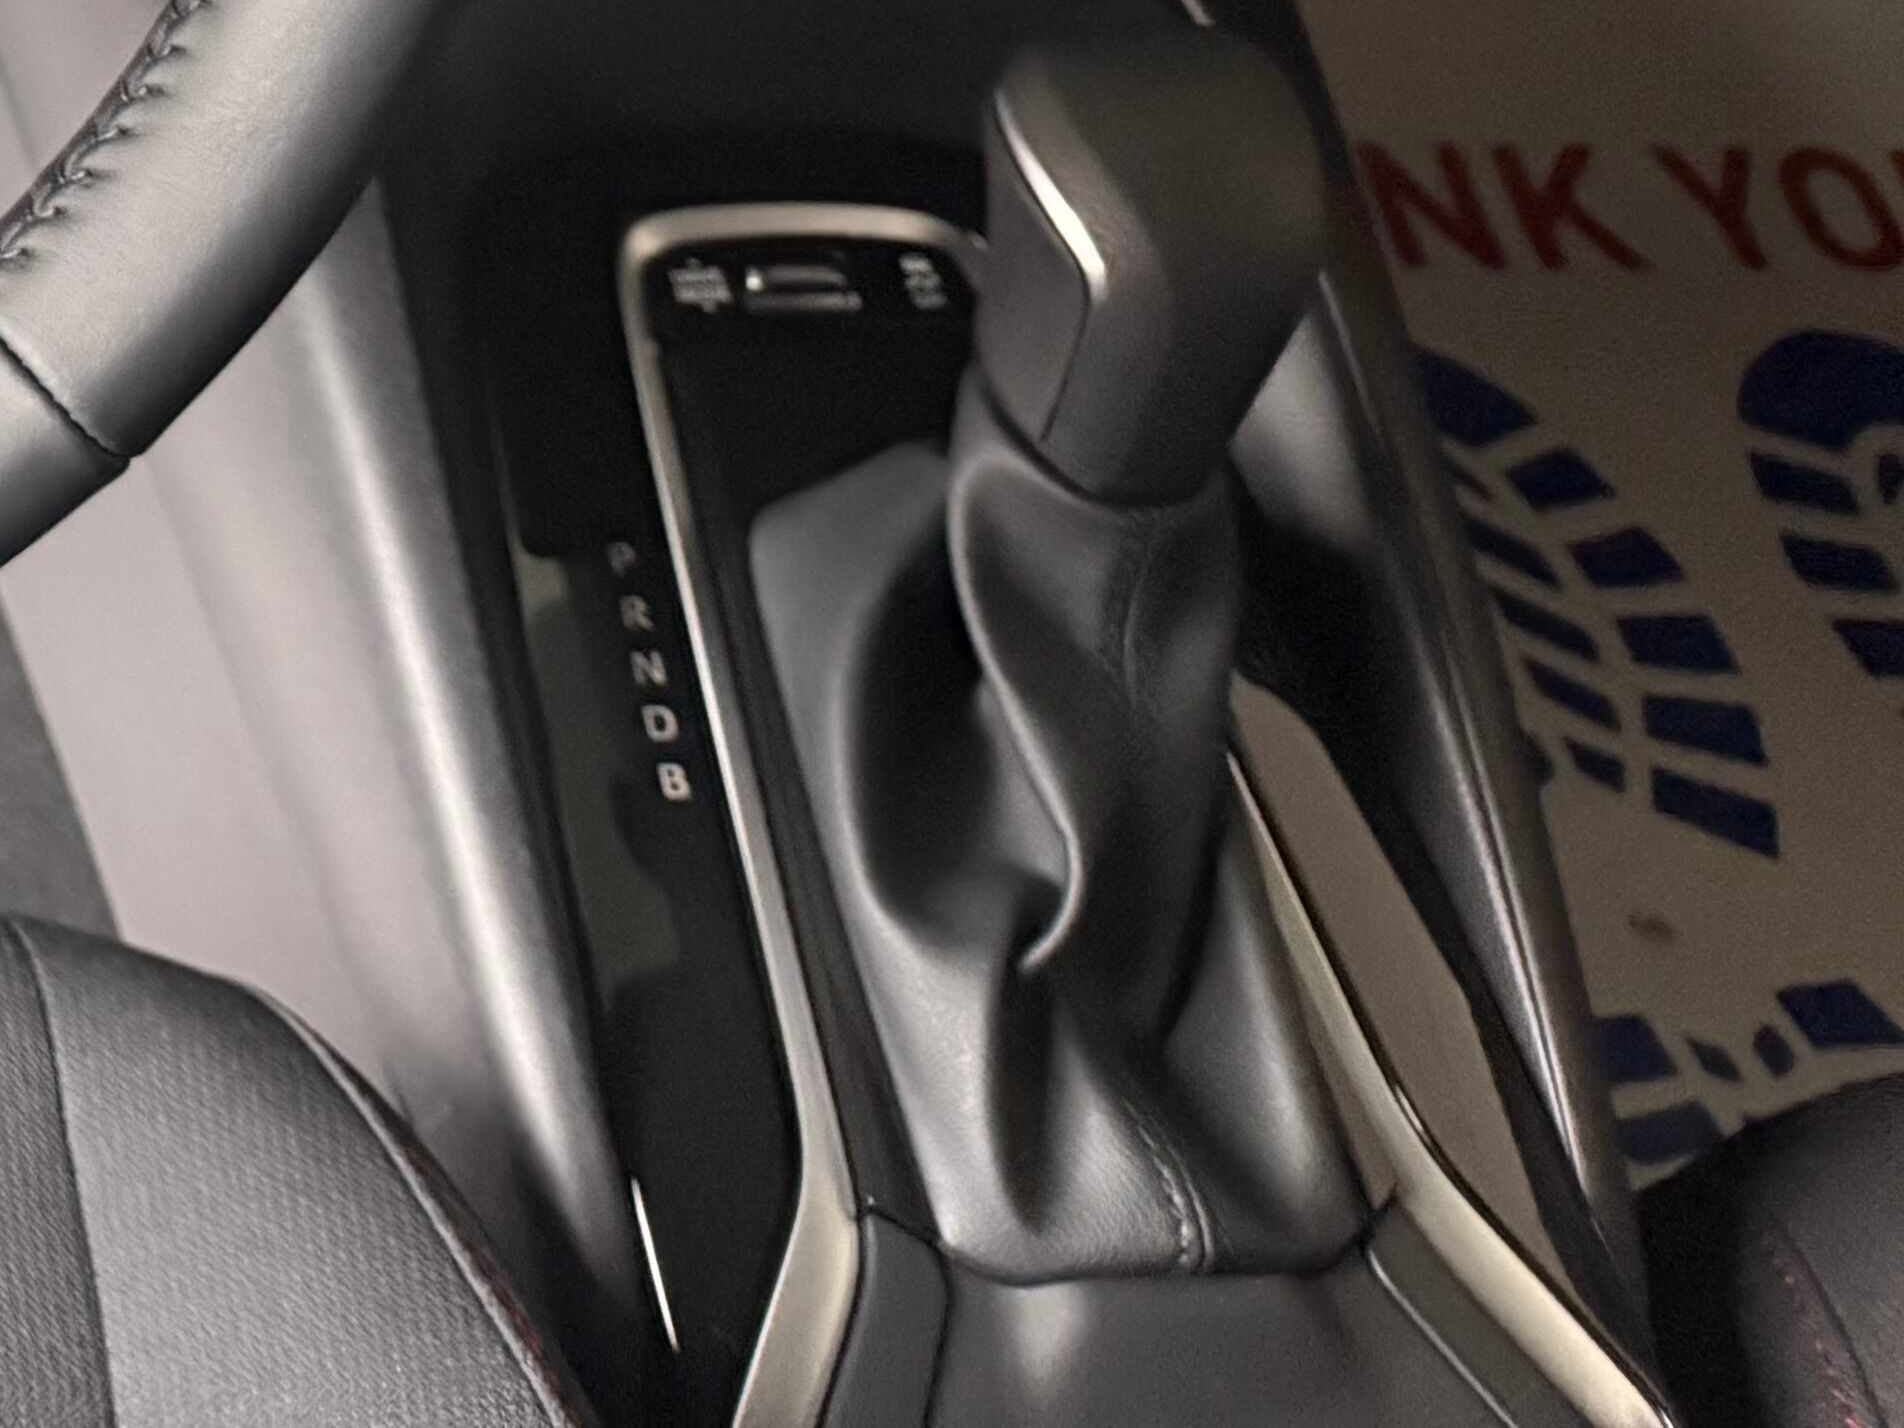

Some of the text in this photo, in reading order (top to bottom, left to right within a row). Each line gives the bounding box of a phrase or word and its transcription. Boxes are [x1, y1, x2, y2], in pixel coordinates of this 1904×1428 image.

[1650, 142, 1904, 272] YO
[630, 650, 669, 687] N
[641, 704, 680, 744] D
[656, 761, 693, 802] B
